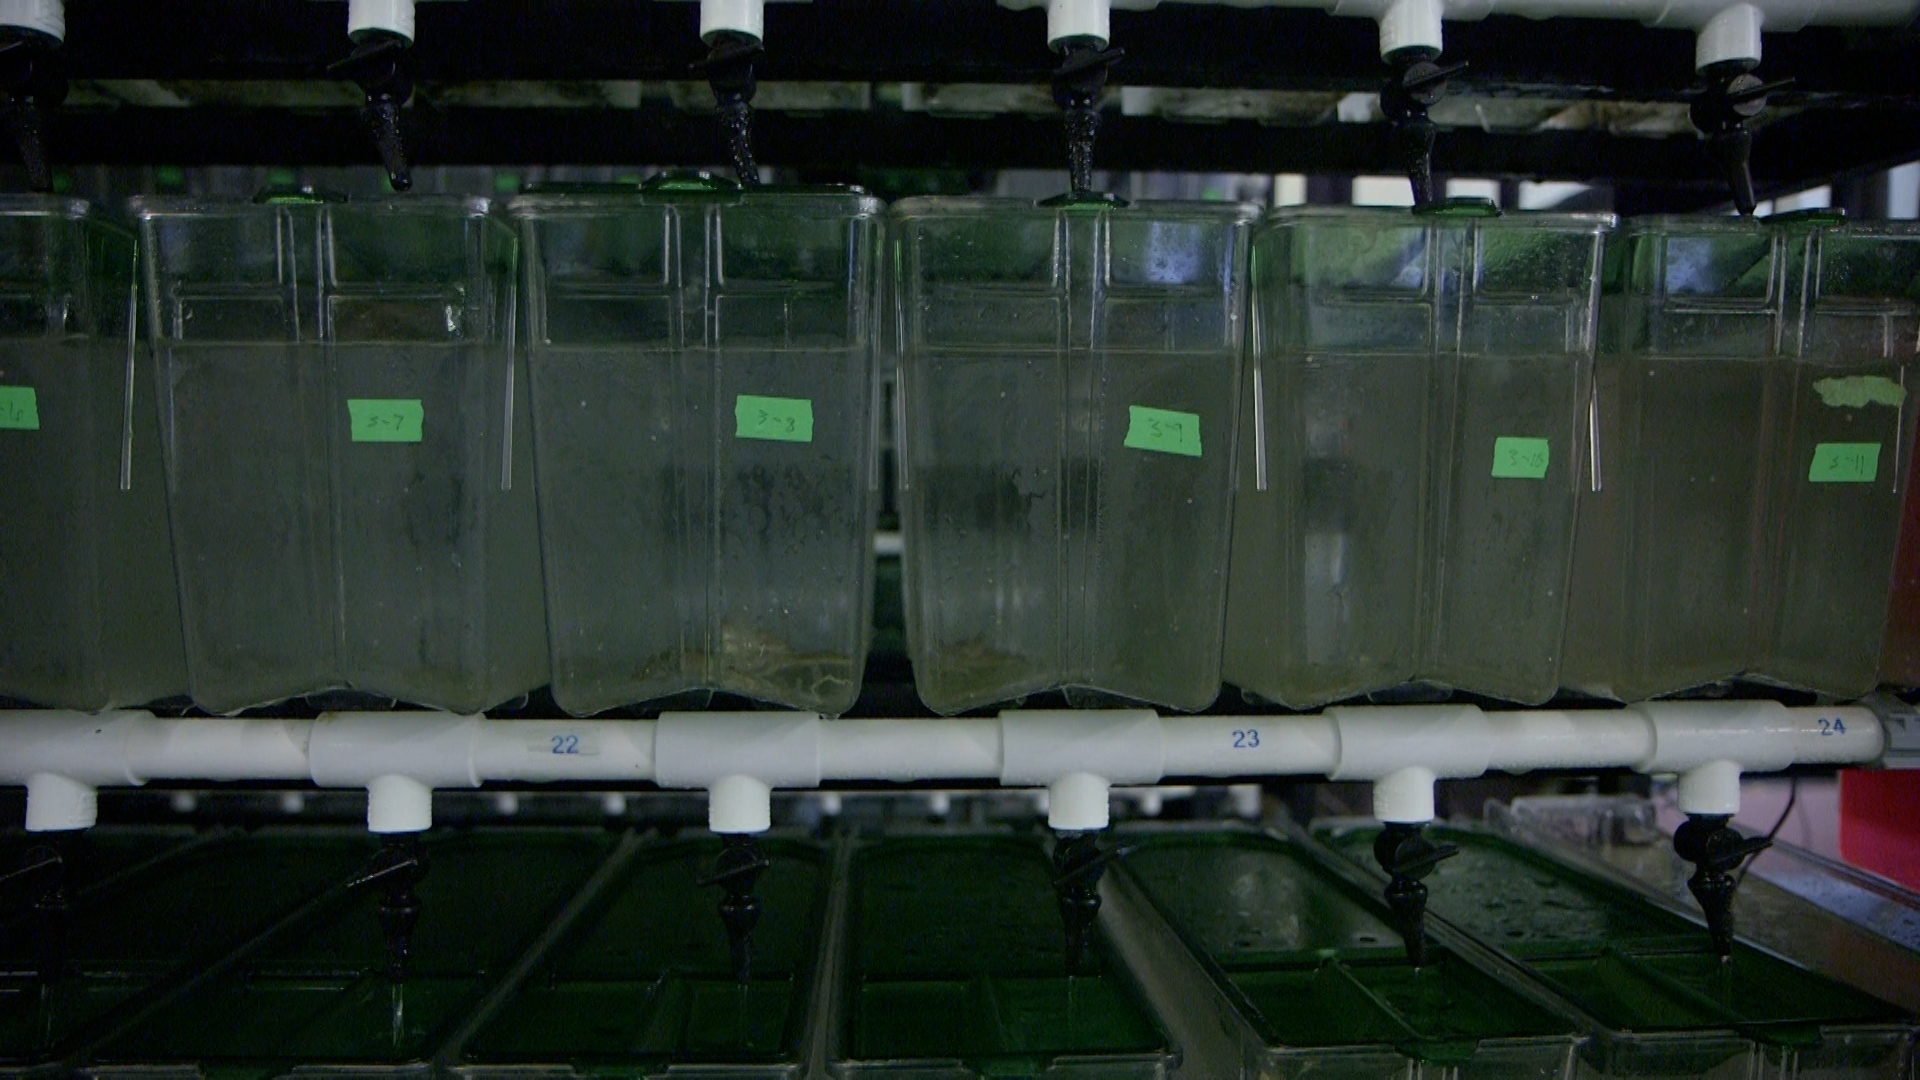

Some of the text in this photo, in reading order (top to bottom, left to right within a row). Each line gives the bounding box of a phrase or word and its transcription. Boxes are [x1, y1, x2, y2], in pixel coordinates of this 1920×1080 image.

[1817, 717, 1847, 737] 24
[551, 735, 579, 754] 22
[1232, 729, 1260, 748] 23
